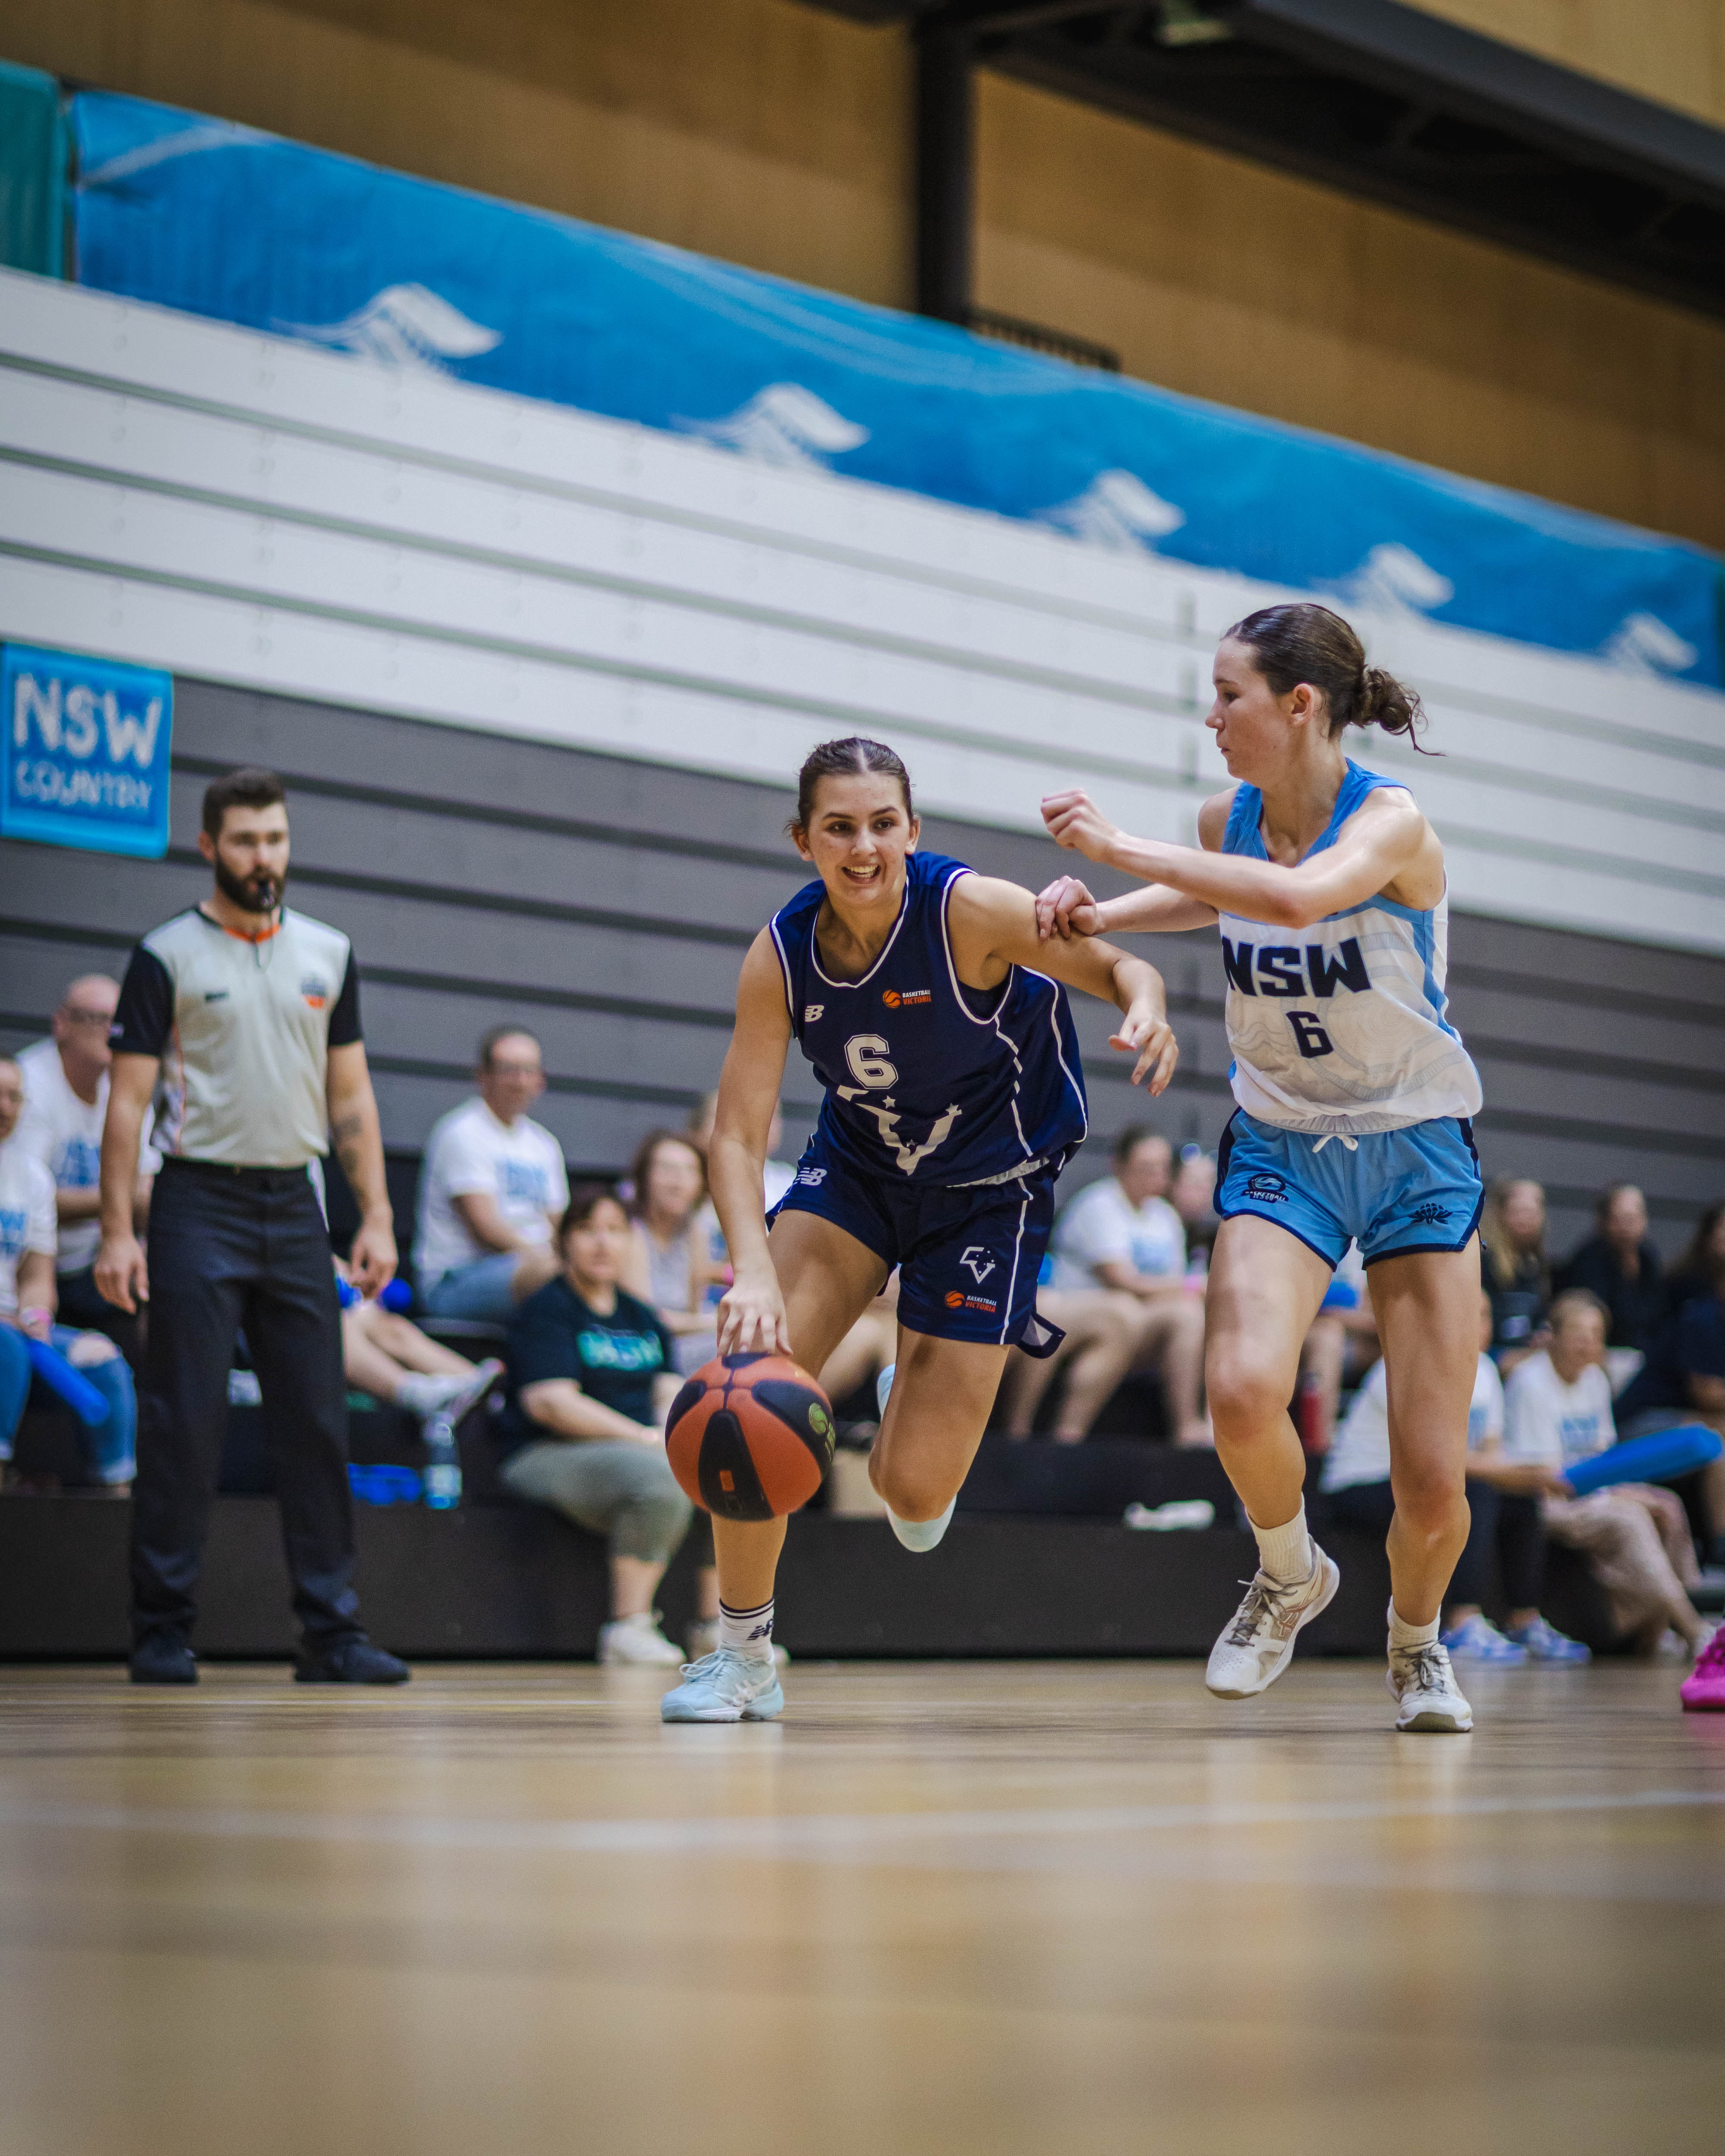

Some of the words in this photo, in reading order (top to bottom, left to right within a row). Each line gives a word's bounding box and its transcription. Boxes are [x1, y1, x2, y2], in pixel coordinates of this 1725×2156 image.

[13, 672, 163, 769] NSW
[1222, 935, 1373, 998] NSW
[1286, 1011, 1334, 1059] 6
[844, 1034, 899, 1089] 6
[965, 1300, 996, 1313] VICTORIA
[967, 1295, 997, 1306] BASKETBALL
